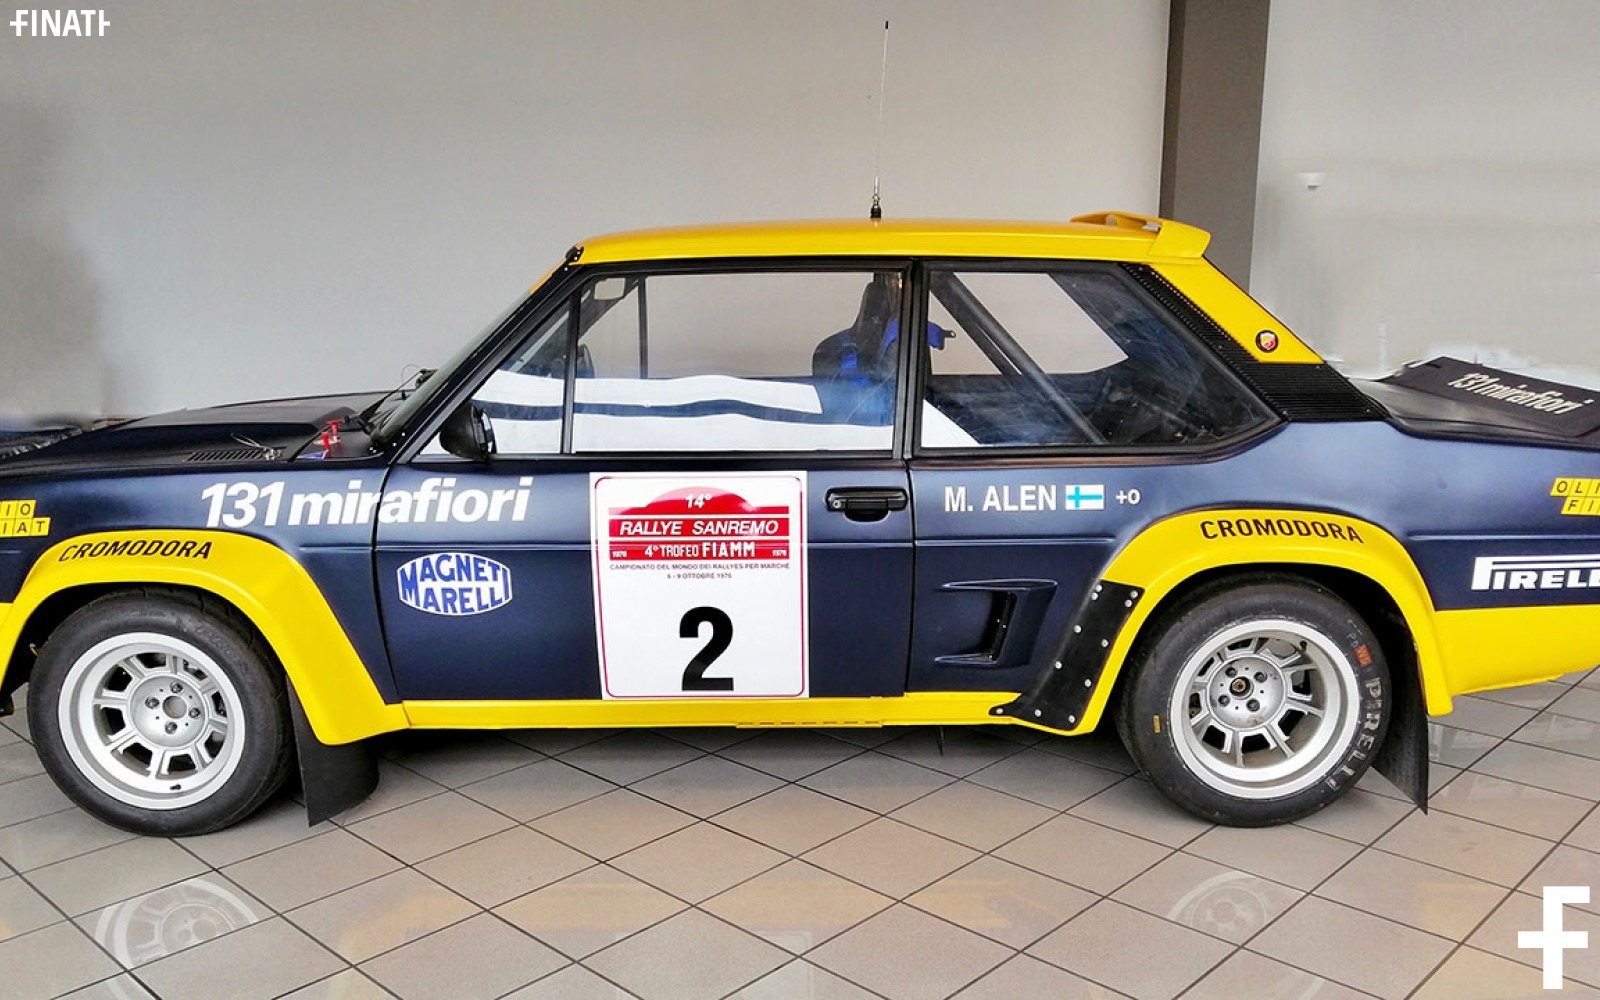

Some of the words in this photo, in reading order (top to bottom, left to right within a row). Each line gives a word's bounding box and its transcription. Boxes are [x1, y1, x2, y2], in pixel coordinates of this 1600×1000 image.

[201, 481, 285, 528] 131
[287, 476, 534, 526] mirafiori
[944, 485, 974, 512] M.
[982, 485, 1057, 512] ALEN
[620, 520, 683, 536] RALLYE
[692, 520, 779, 536] SANREMO
[1200, 518, 1365, 544] CROMODORA
[58, 539, 213, 562] CROMODORA
[660, 544, 699, 558] TROFEO
[702, 541, 756, 558] FIAMM
[400, 553, 510, 592] MAGNETI
[679, 606, 735, 691] 2
